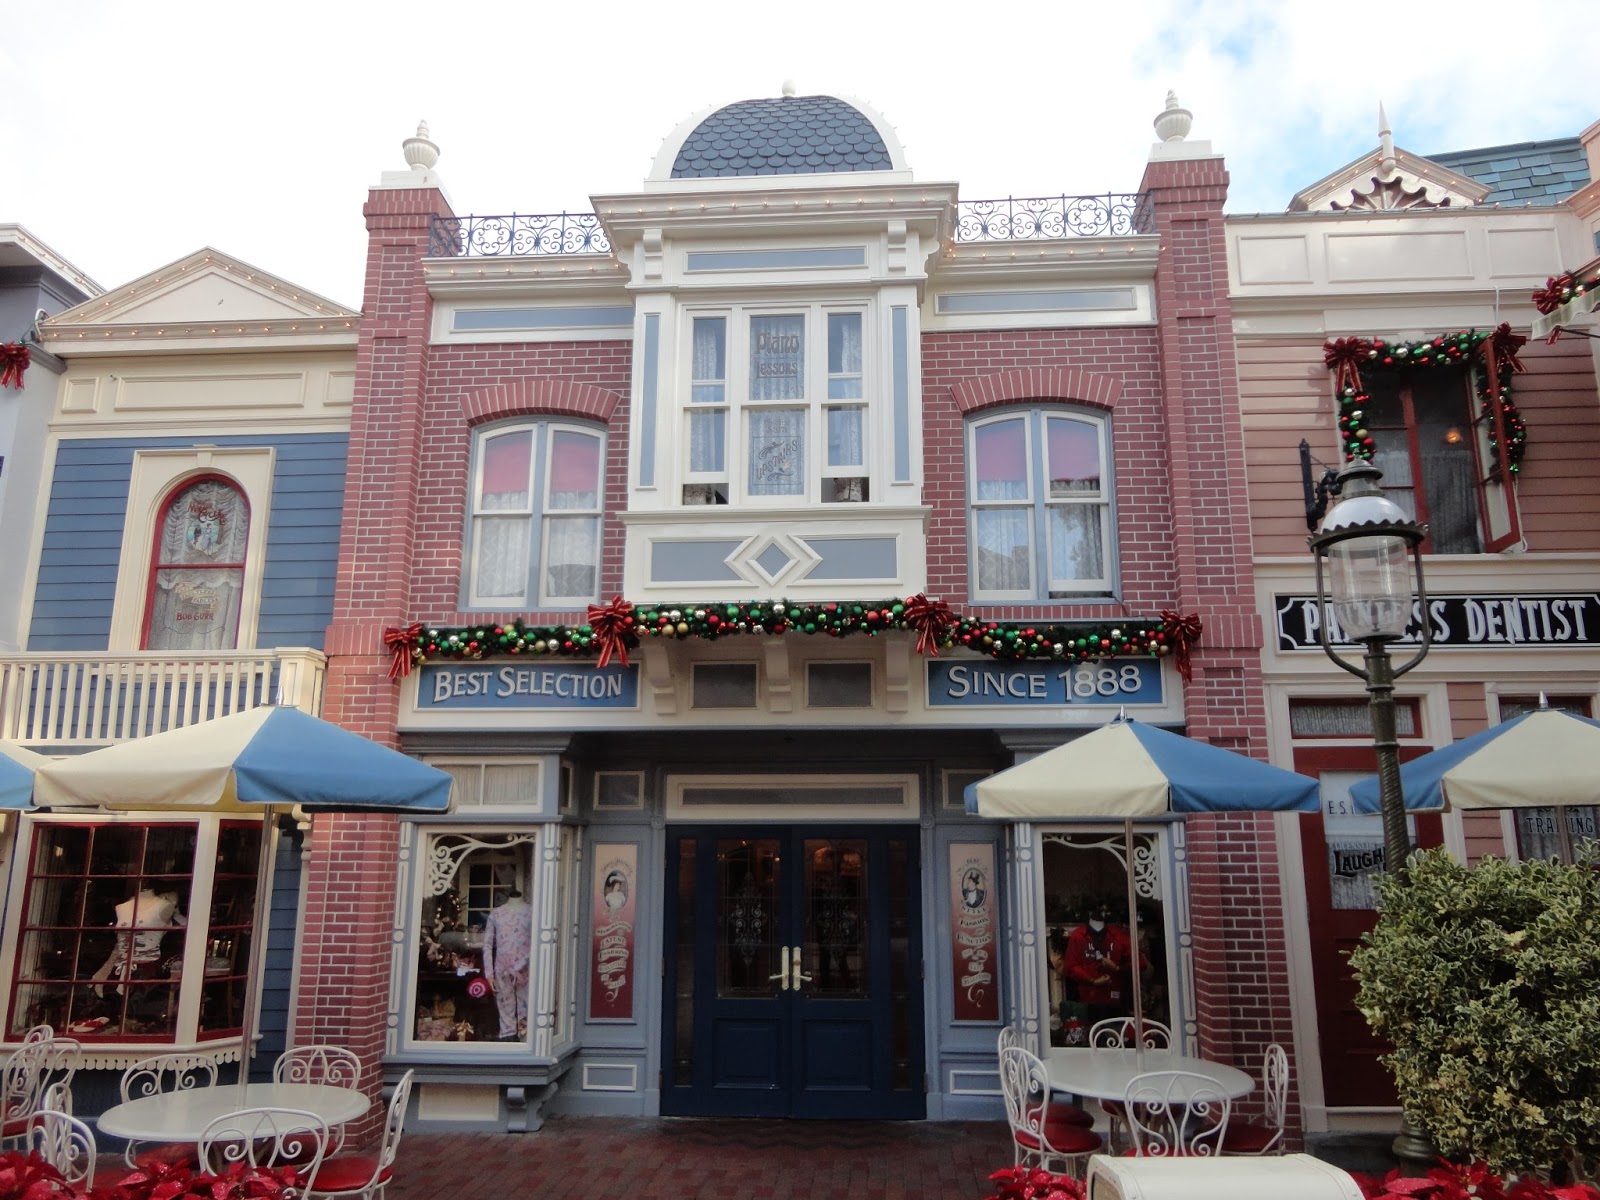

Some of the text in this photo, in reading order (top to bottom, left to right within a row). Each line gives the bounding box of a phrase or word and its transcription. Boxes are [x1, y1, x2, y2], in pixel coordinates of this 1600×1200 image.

[757, 332, 799, 355] Piano
[756, 361, 798, 378] Lessons
[756, 439, 798, 480] UPSTAIRS
[1463, 596, 1587, 645] DENTIST
[433, 667, 623, 703] BEST SELECTION
[948, 664, 1142, 701] SINCE 1888
[1526, 817, 1593, 834] TRAIING
